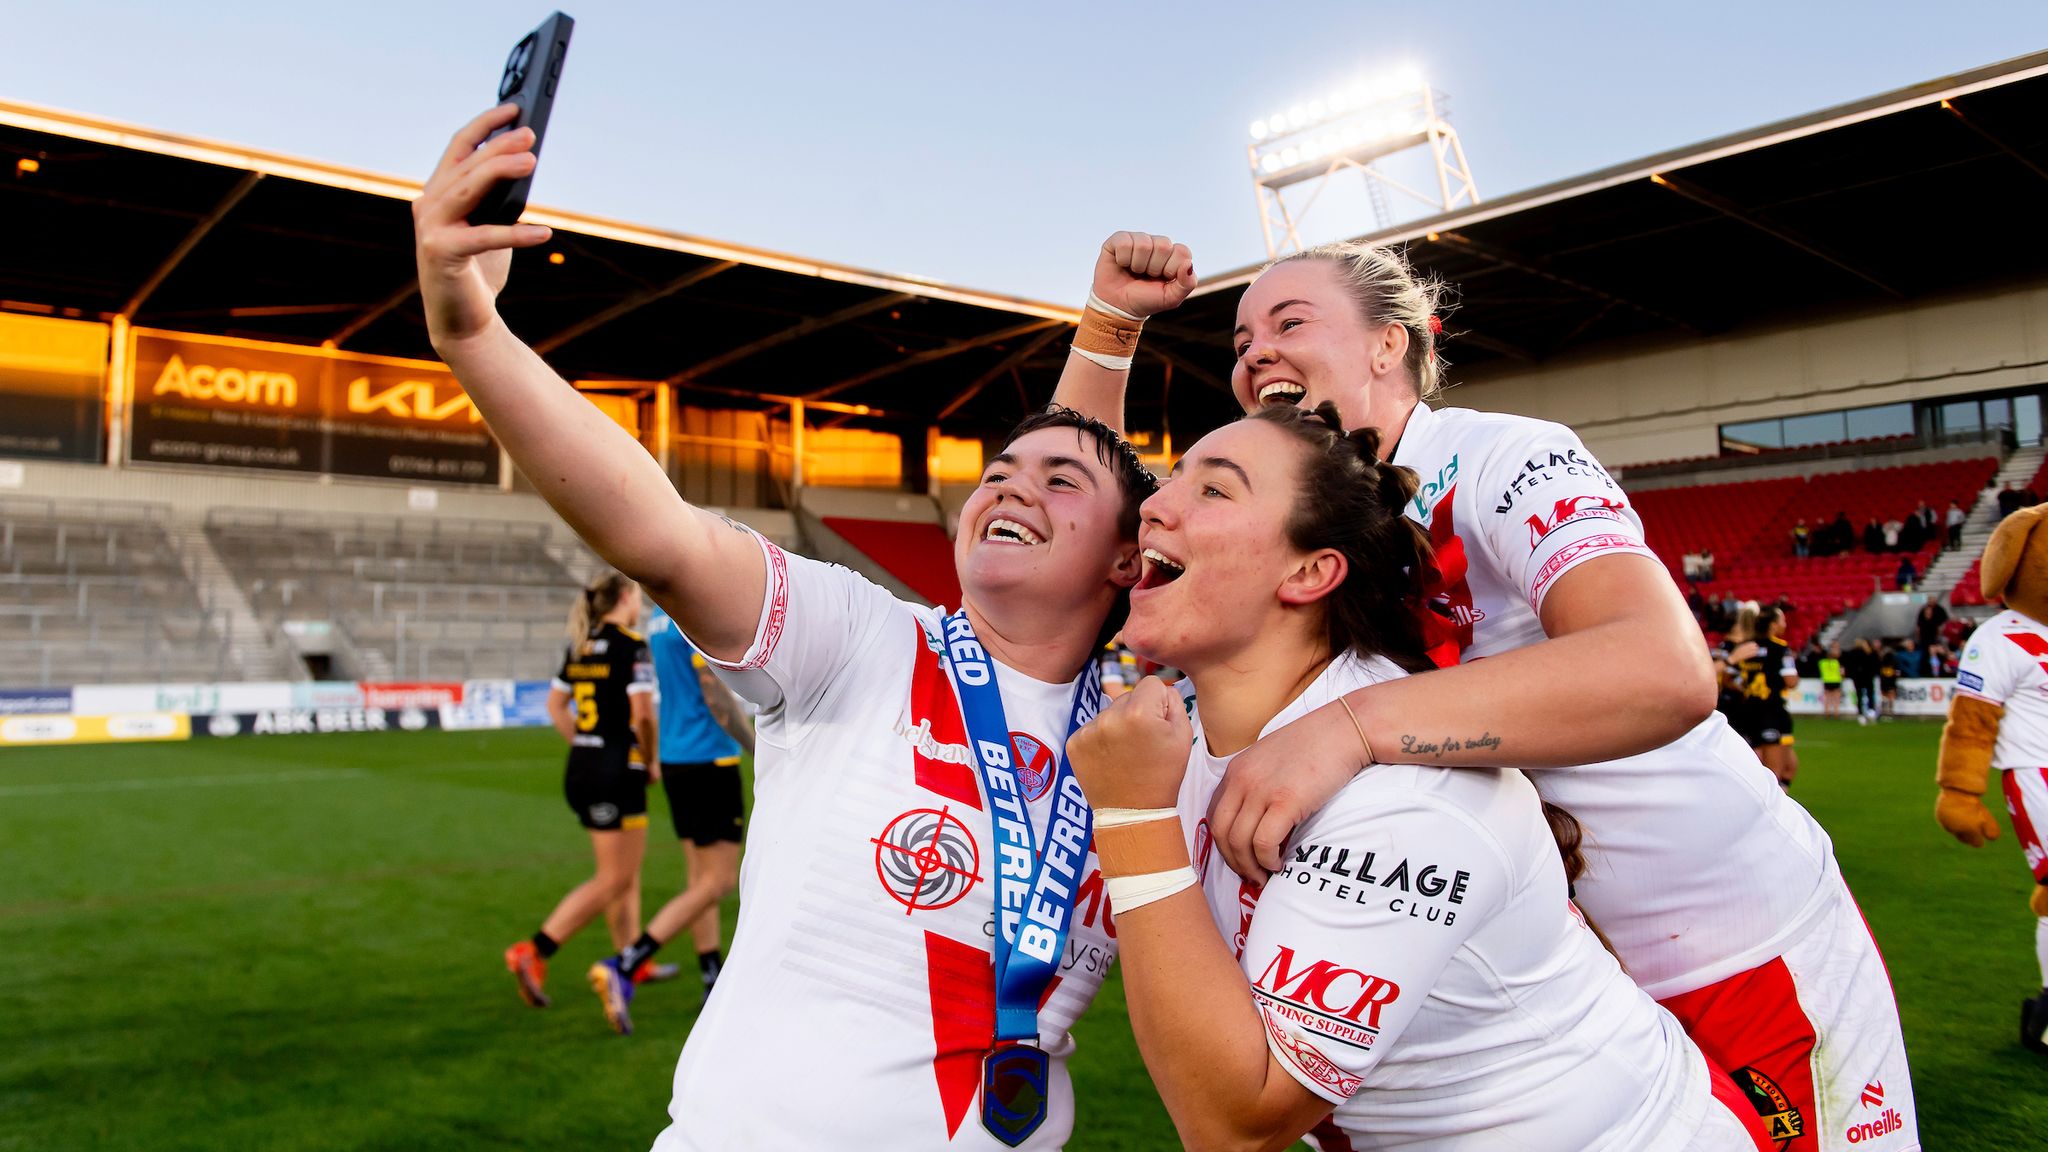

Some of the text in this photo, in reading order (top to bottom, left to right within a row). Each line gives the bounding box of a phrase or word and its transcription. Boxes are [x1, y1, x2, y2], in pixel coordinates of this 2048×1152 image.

[153, 353, 298, 408] Acorn
[1513, 473, 1553, 496] TEL
[316, 707, 387, 732] BEER
[573, 682, 599, 732] 5
[1401, 731, 1502, 758] Live for today
[977, 739, 1034, 946] BETFRED
[1017, 775, 1089, 964] BETFRED
[1281, 864, 1457, 927] HOTEL CLUB
[1295, 844, 1471, 905] VILLAGE
[1252, 944, 1401, 1030] MCR
[1315, 1017, 1376, 1047] SUPPLIES
[1755, 1076, 1785, 1109] STRONG
